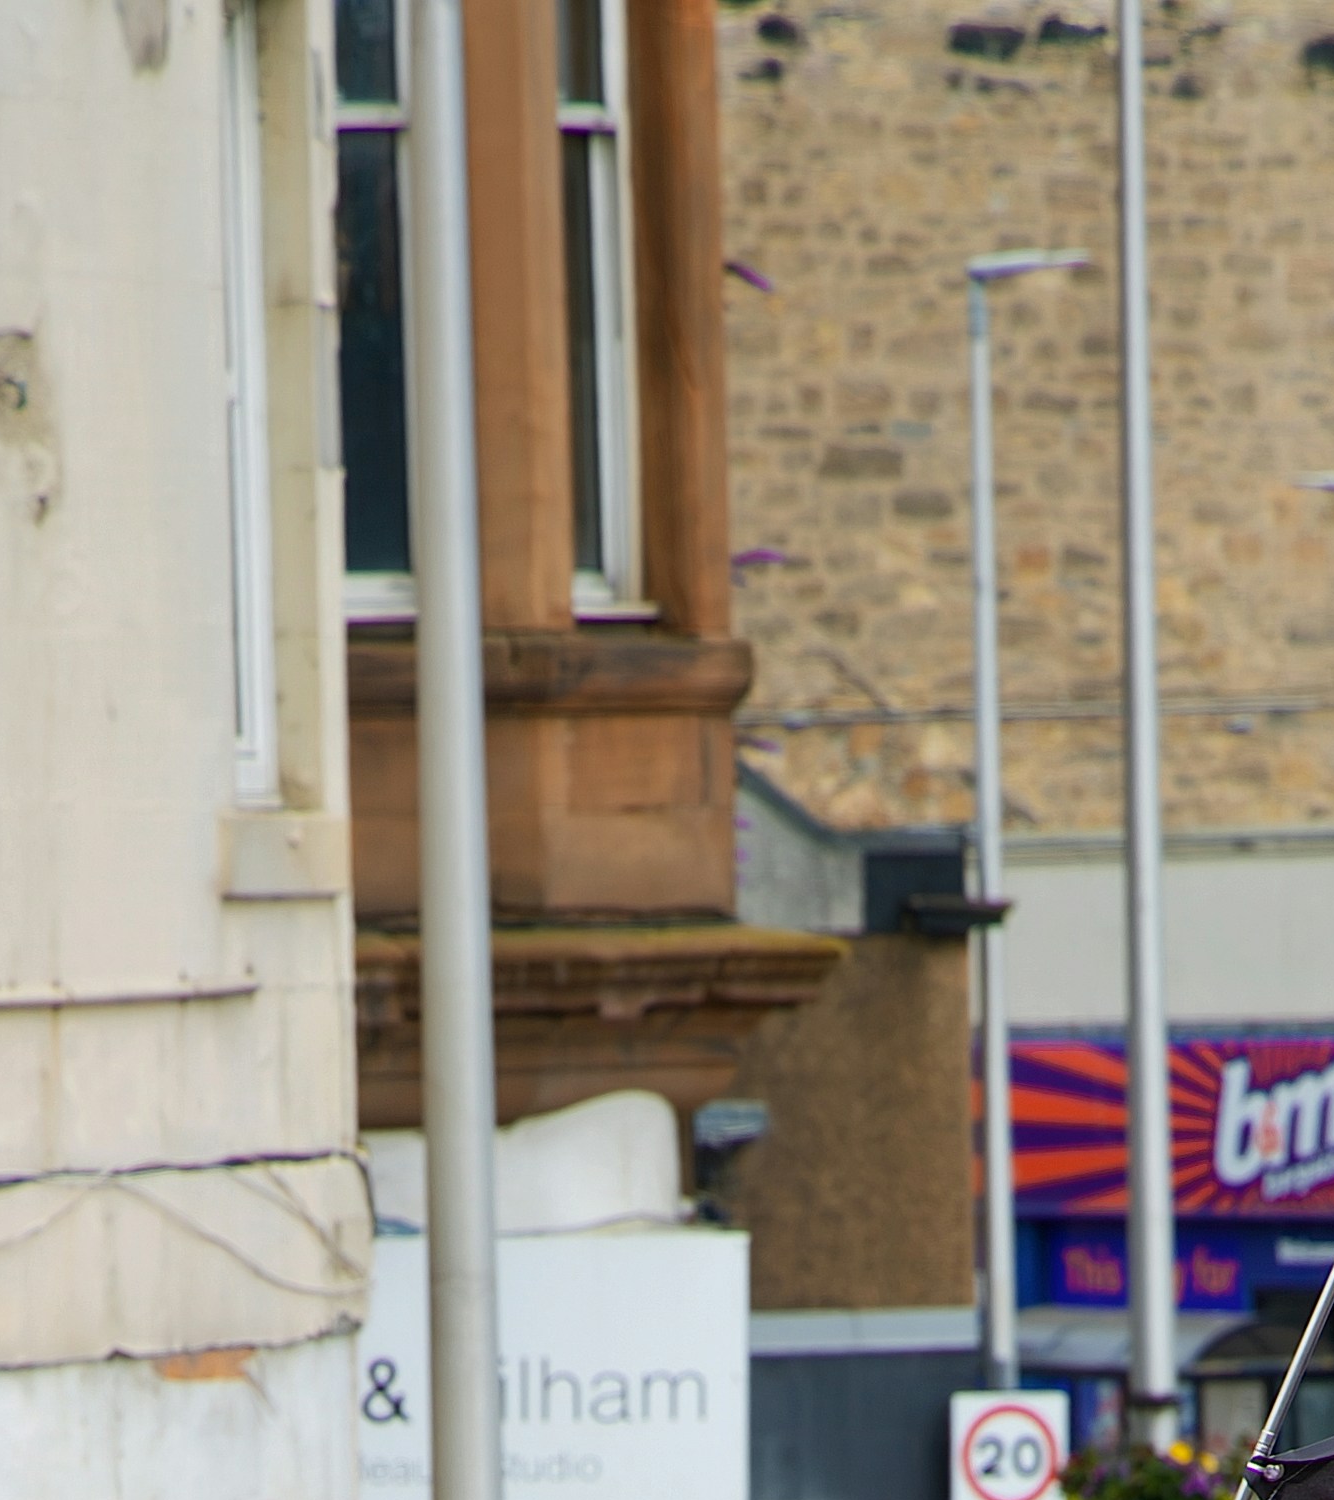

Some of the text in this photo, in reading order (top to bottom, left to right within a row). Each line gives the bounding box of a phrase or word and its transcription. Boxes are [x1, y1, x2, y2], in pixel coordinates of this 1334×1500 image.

[361, 1354, 708, 1425] & ilham
[976, 1434, 1043, 1478] 20
